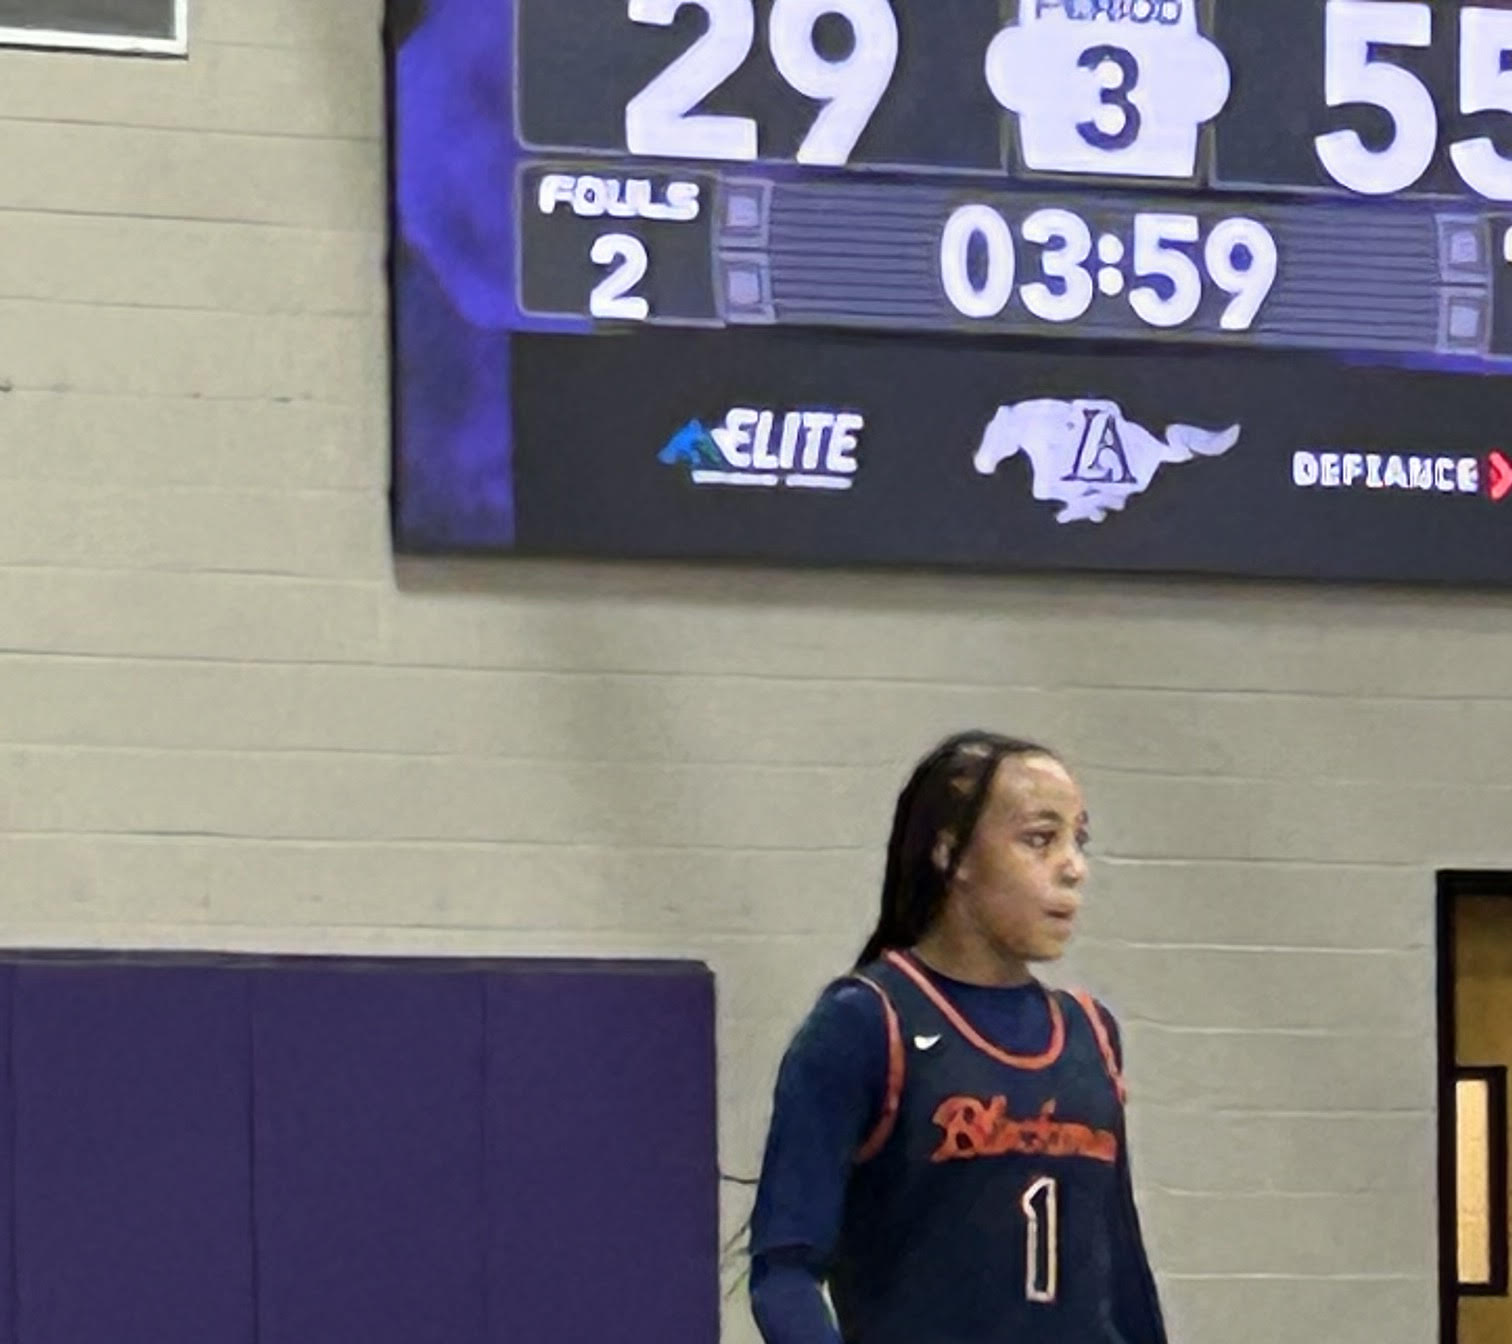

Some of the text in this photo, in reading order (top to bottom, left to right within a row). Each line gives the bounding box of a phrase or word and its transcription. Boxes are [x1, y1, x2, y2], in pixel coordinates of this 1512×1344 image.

[626, 0, 899, 166] 29
[1075, 44, 1142, 152] 3
[538, 174, 700, 221] FOULS
[589, 233, 649, 320] 2
[940, 204, 1278, 331] 03:59
[1292, 450, 1479, 493] DEFIANCE
[1022, 1176, 1057, 1302] 1
